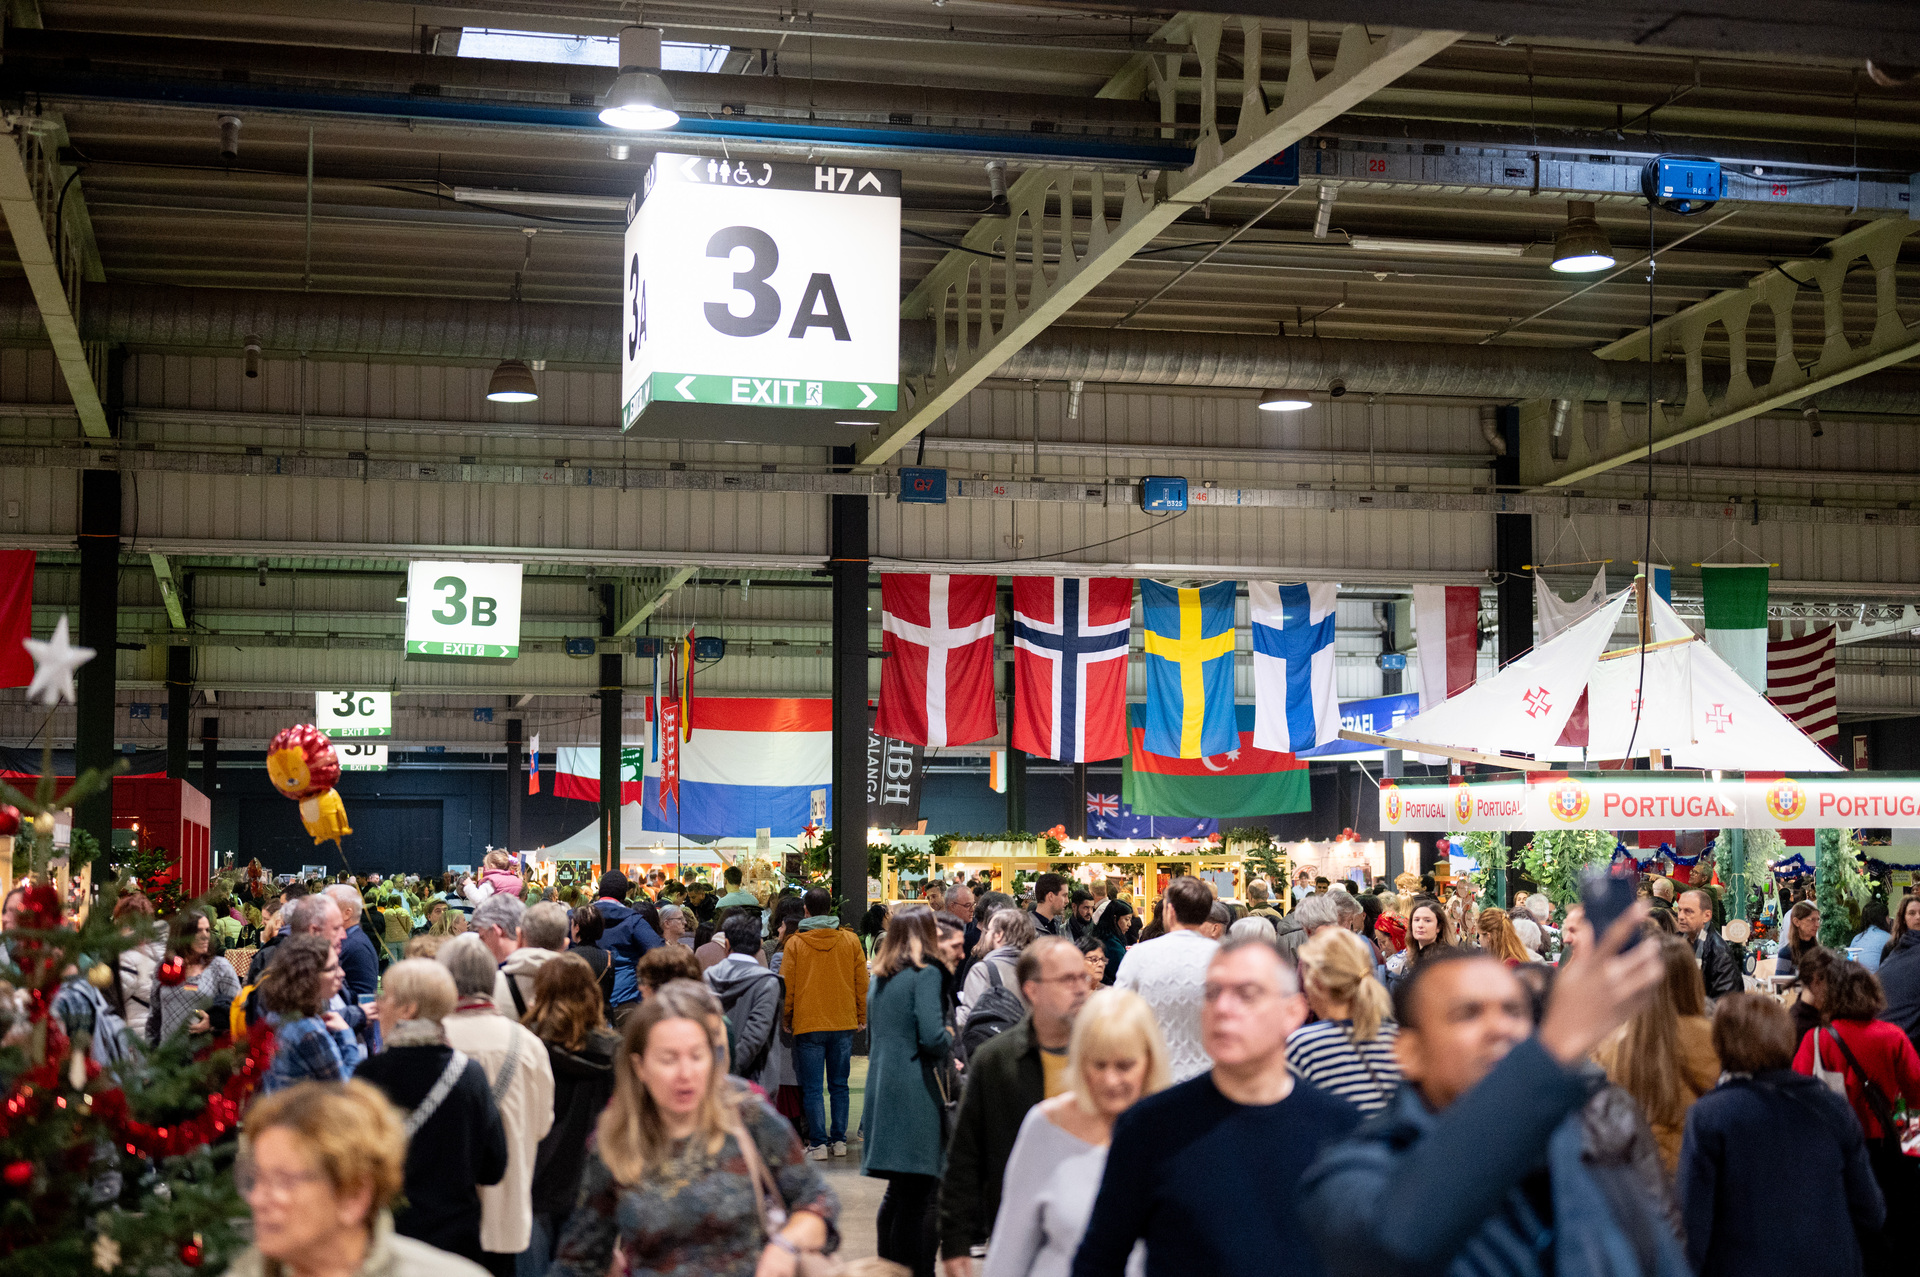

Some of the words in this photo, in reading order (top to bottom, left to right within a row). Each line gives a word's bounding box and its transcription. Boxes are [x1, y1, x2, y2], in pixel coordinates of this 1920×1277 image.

[1369, 159, 1386, 172] 28
[814, 166, 854, 191] H7
[1772, 184, 1788, 196] 29
[703, 225, 852, 342] 3A
[628, 252, 648, 362] 3A
[731, 377, 801, 407] EXIT
[914, 478, 934, 491] Q7
[993, 486, 1005, 495] 45
[1196, 493, 1207, 502] 46
[431, 575, 498, 627] 3B
[443, 643, 474, 656] EXIT
[332, 691, 375, 717] 3C
[342, 729, 362, 737] EXIT
[1341, 713, 1376, 735] SRAEL
[1405, 801, 1446, 818] PORTUGAL
[1477, 798, 1523, 817] PORTUGAL
[1603, 792, 1735, 818] PORTUGAL
[1819, 792, 1920, 817] PORTUG
